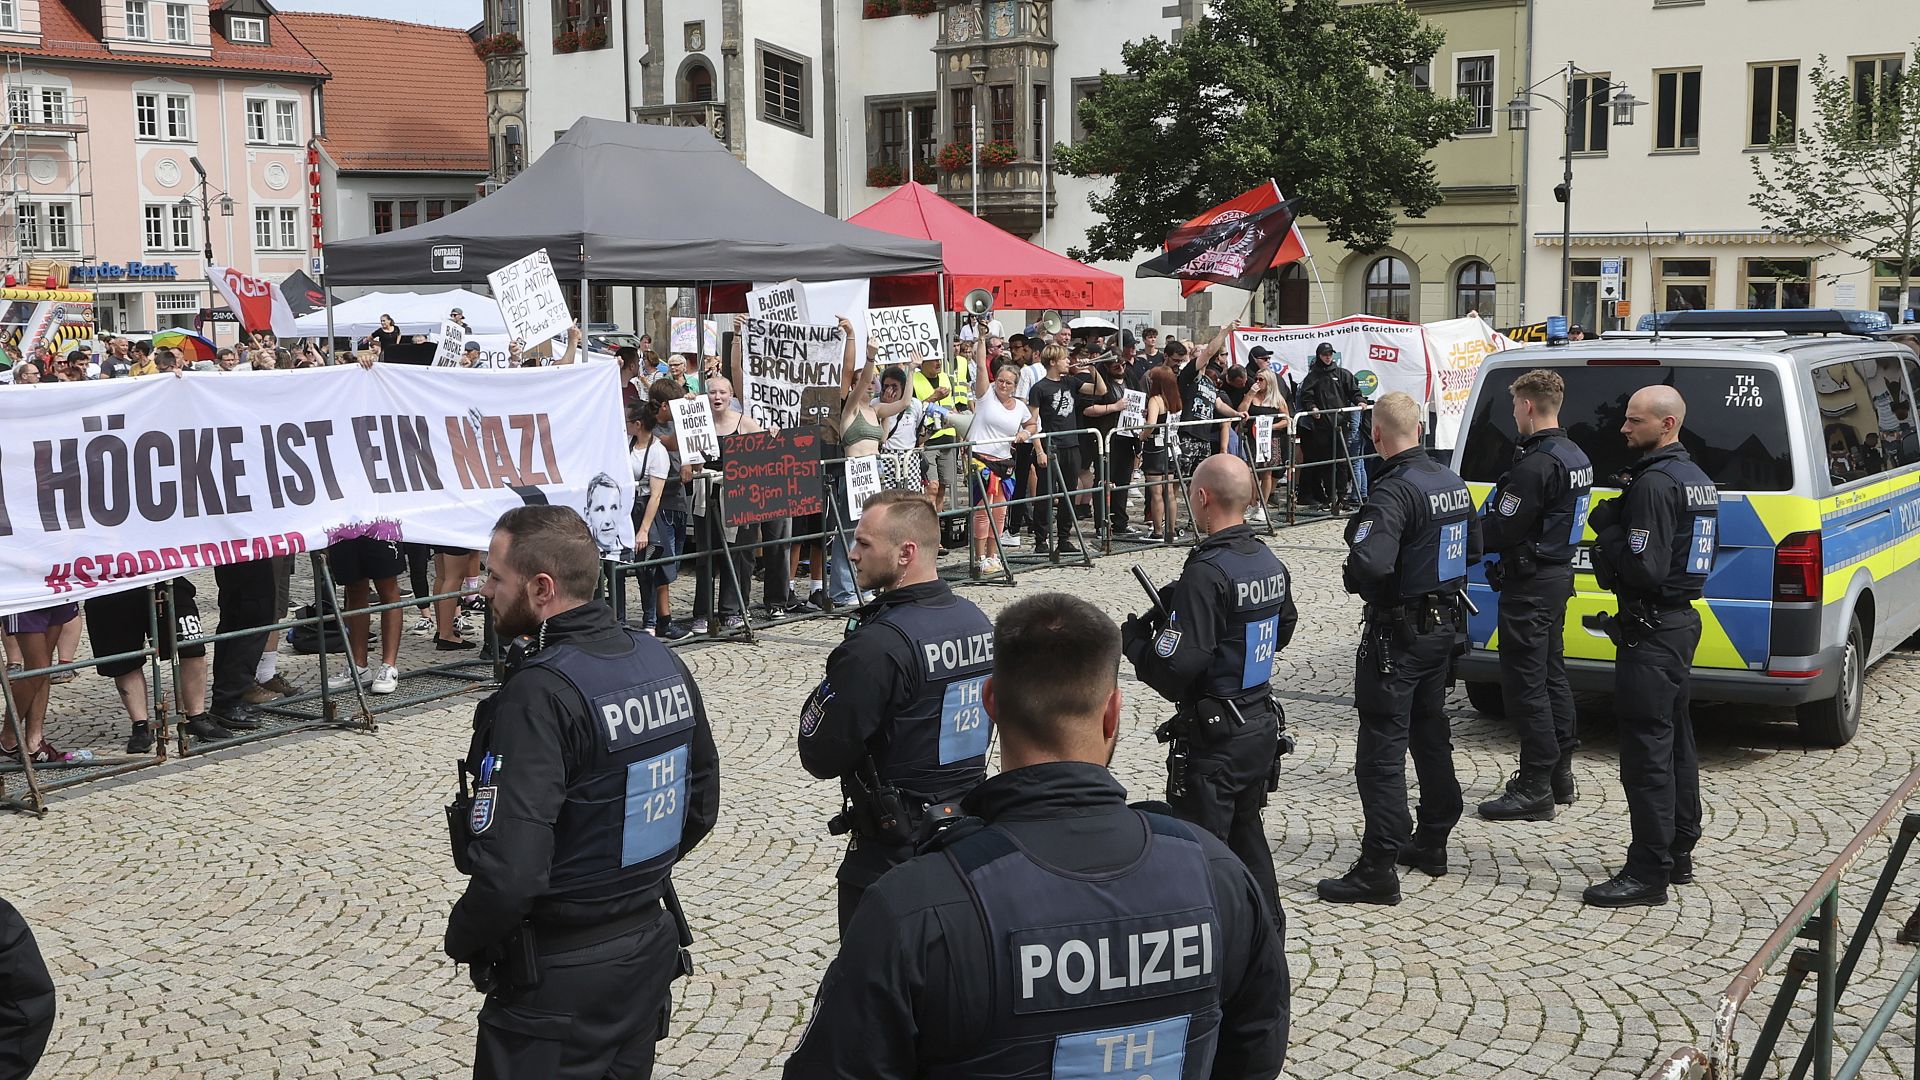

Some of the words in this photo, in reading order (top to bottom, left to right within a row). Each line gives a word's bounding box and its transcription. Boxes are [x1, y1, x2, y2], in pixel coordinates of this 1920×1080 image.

[434, 248, 460, 256] OUTRANGE
[497, 264, 519, 286] BIST
[522, 256, 539, 273] DU
[502, 284, 521, 308] ANTI
[524, 267, 557, 295] ANTIFA
[508, 299, 530, 323] BIST
[535, 289, 554, 310] DU
[758, 288, 795, 311] BJÖRN
[213, 312, 234, 320] 24MX
[870, 308, 913, 326] MAKE
[748, 318, 765, 335] ES
[769, 321, 806, 340] KANN
[809, 326, 841, 342] NUR
[871, 322, 931, 343] RACISTS
[1242, 334, 1260, 342] Der
[1262, 332, 1315, 342] Rechtsruck
[1317, 329, 1334, 339] hat
[1336, 326, 1360, 335] viele
[748, 333, 807, 360] EINEN
[876, 338, 939, 361] AFRAID!
[1370, 348, 1396, 361] SPD
[749, 355, 841, 385] BRAUNEN
[1735, 375, 1755, 385] TH
[751, 382, 799, 407] BERND
[1725, 396, 1763, 407] 71/10
[1730, 386, 1748, 396] LP
[1752, 386, 1760, 396] 6
[680, 401, 705, 415] BJÖRN
[683, 415, 707, 430] HÖCKE
[686, 433, 712, 453] NAZI
[33, 414, 252, 532] HÖCKE
[260, 419, 344, 509] IST
[352, 415, 444, 493] EIN
[445, 413, 563, 490] NAZI
[850, 461, 871, 475] BJÖRN
[852, 474, 873, 487] HÖCKE
[728, 484, 746, 498] mit
[749, 483, 782, 509] Björn
[787, 477, 801, 496] H.
[1450, 525, 1462, 541] TH
[1702, 520, 1712, 534] TH
[1447, 542, 1462, 559] 124
[1699, 538, 1712, 553] 124
[1259, 621, 1273, 640] TH
[924, 632, 994, 673] POLIZE
[1255, 641, 1272, 662] 124
[959, 681, 979, 705] TH
[602, 683, 694, 741] POLIZEI
[954, 708, 980, 733] 123
[647, 756, 675, 789] TH
[643, 788, 676, 824] 123
[1020, 922, 1213, 999] POLIZEI
[1096, 1030, 1155, 1073] TH
